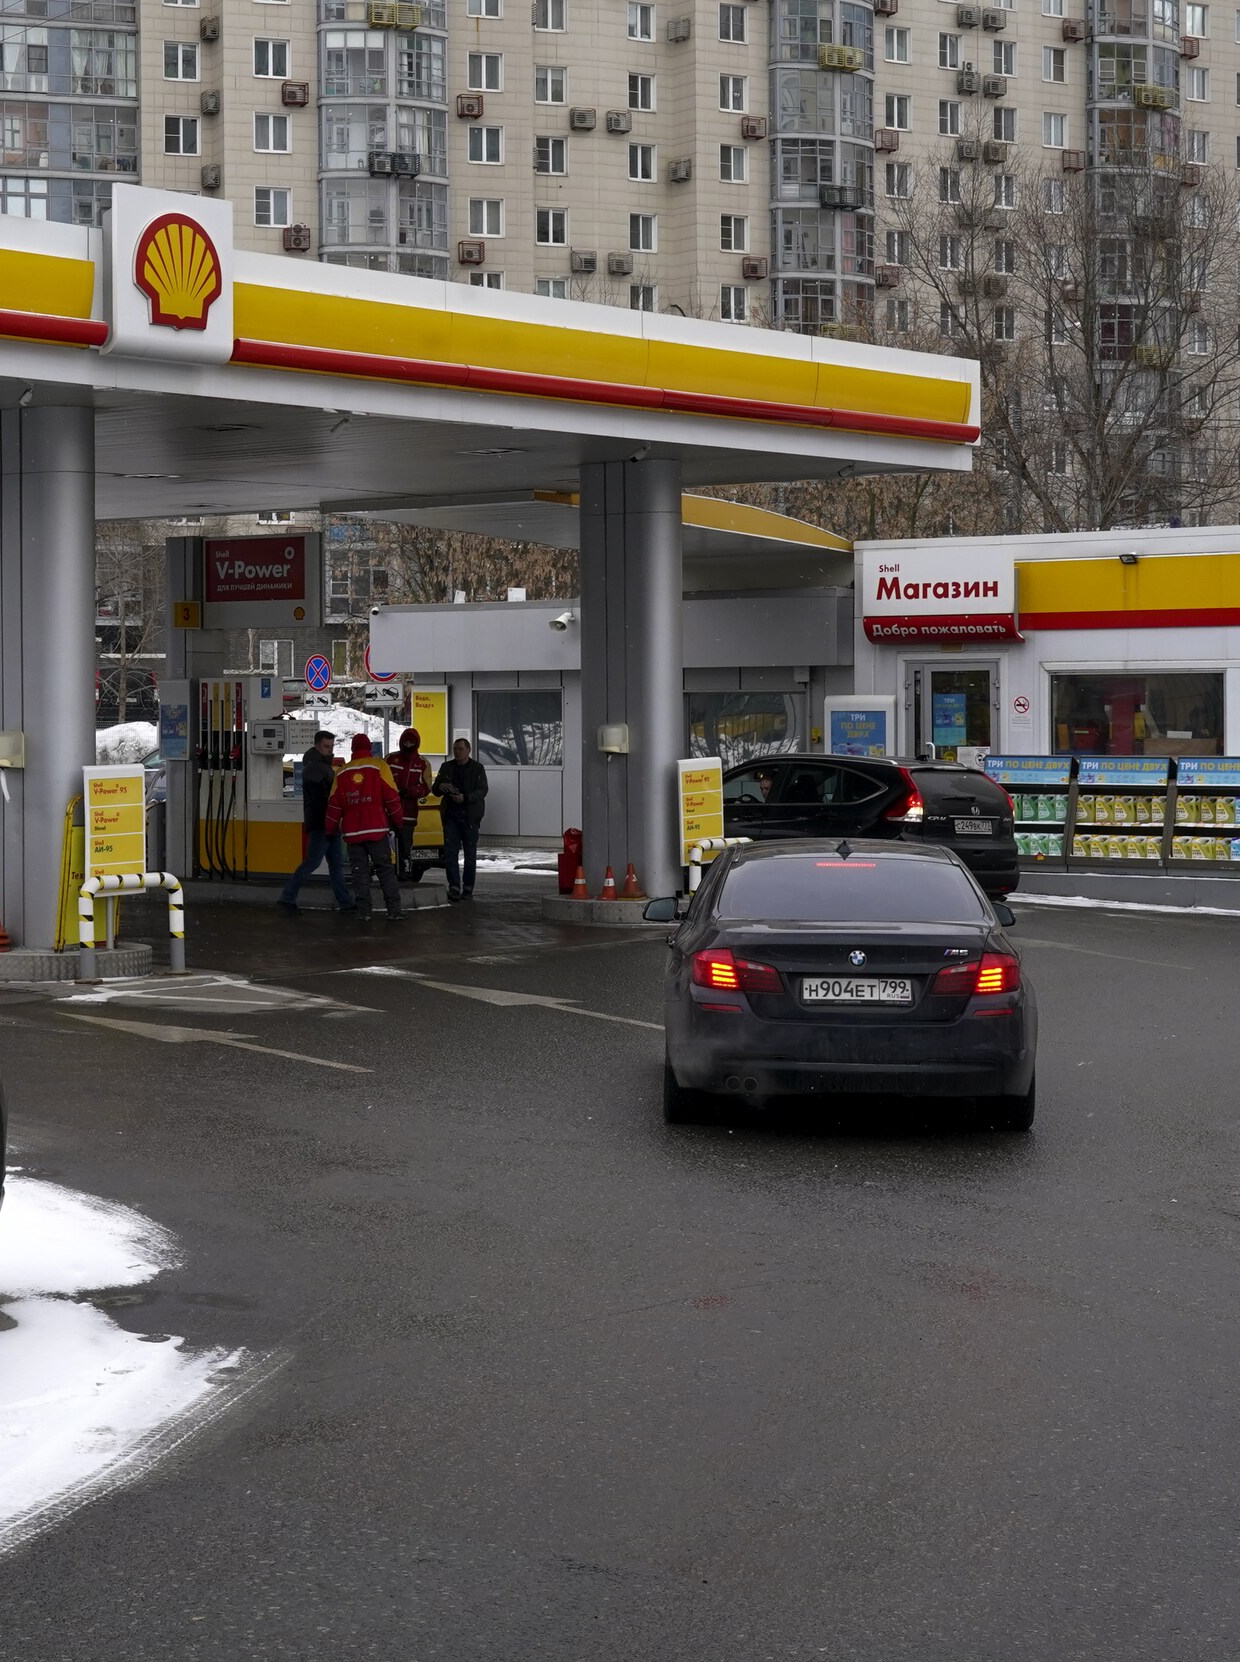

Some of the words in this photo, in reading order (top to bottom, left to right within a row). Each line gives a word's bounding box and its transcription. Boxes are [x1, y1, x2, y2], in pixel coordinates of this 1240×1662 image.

[215, 550, 230, 558] Shell
[215, 560, 291, 580] V-Power
[878, 564, 900, 573] Shell
[230, 582, 256, 592] ЛУЧШЕЙ
[256, 582, 293, 592] ДИНАМИКИ
[876, 576, 999, 601] Магазин
[183, 607, 190, 621] 3
[872, 624, 918, 638] Добро
[921, 624, 1006, 636] пожаловать
[850, 713, 866, 721] ТРИ
[987, 760, 1003, 768] ТРИ
[1005, 760, 1019, 768] ПО
[1021, 761, 1044, 769] ЦЕНЕ
[1045, 761, 1069, 770] ДВУХ
[1082, 761, 1099, 769] ТРИ
[1100, 761, 1115, 770] ПО
[1117, 762, 1140, 771] ЦЕНЕ
[1141, 762, 1167, 771] ДВУХ
[1180, 762, 1198, 770] ТРИ
[1200, 762, 1215, 770] ПО
[119, 786, 127, 794] 95
[94, 845, 113, 853] АИ-95
[880, 980, 907, 993] 799
